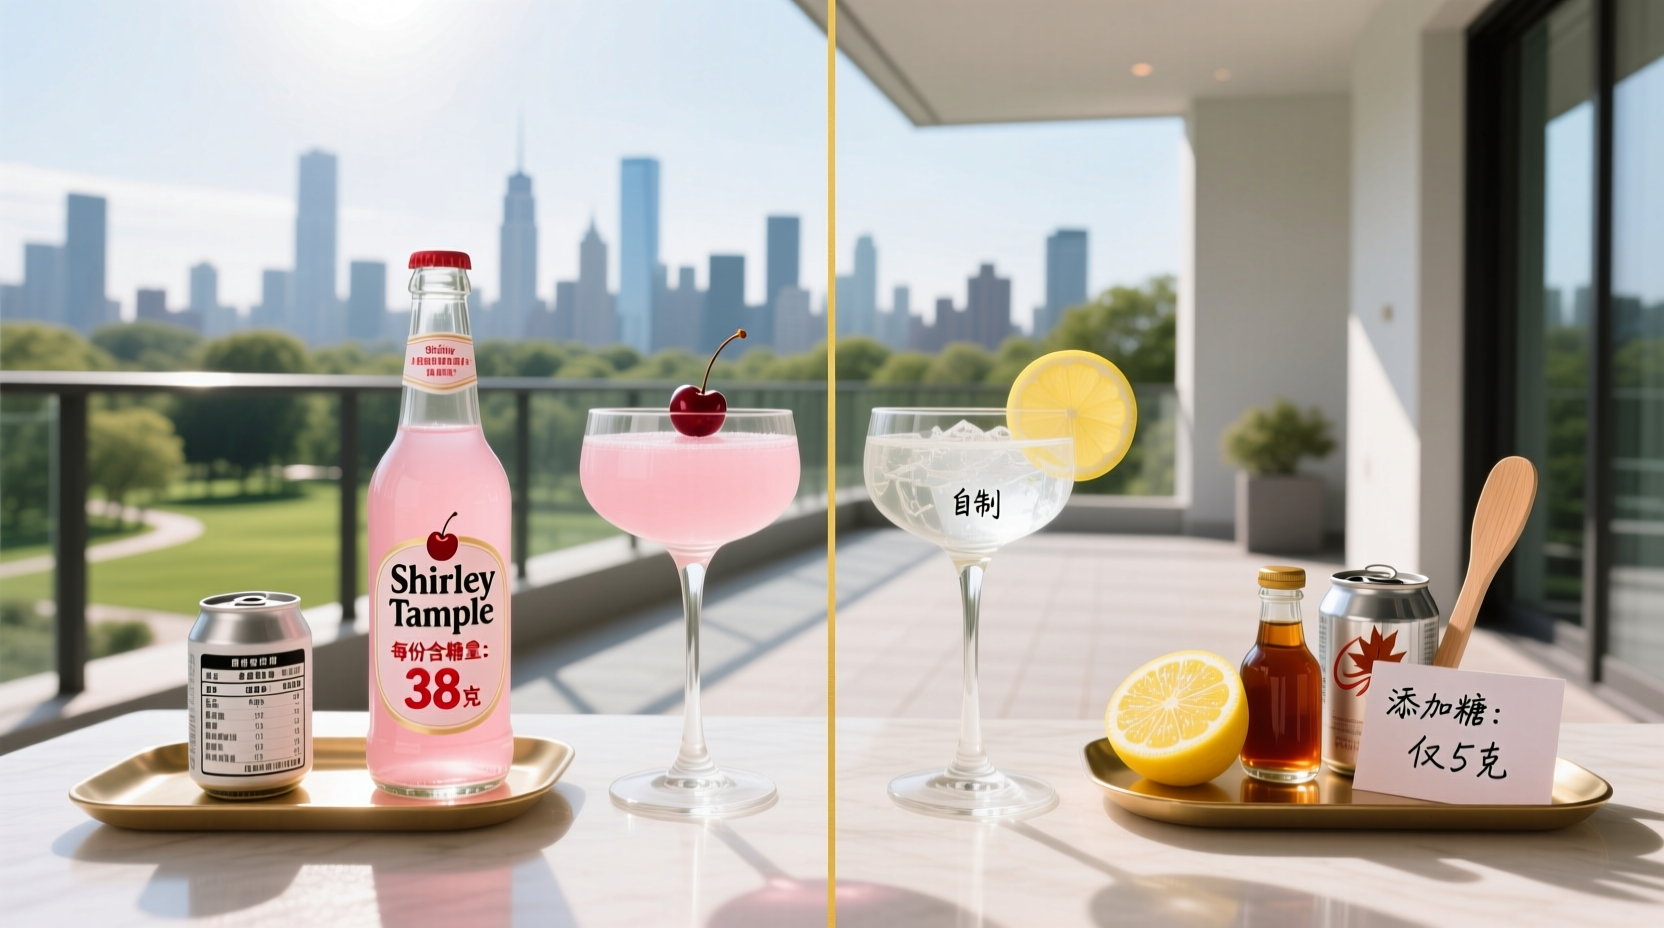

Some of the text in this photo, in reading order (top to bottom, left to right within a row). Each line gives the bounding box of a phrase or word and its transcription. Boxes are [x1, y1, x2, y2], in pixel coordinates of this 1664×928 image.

[953, 487, 1001, 520] 自制
[390, 563, 496, 601] Shirley
[389, 597, 494, 635] Tample
[1408, 735, 1507, 780] 仅5克
